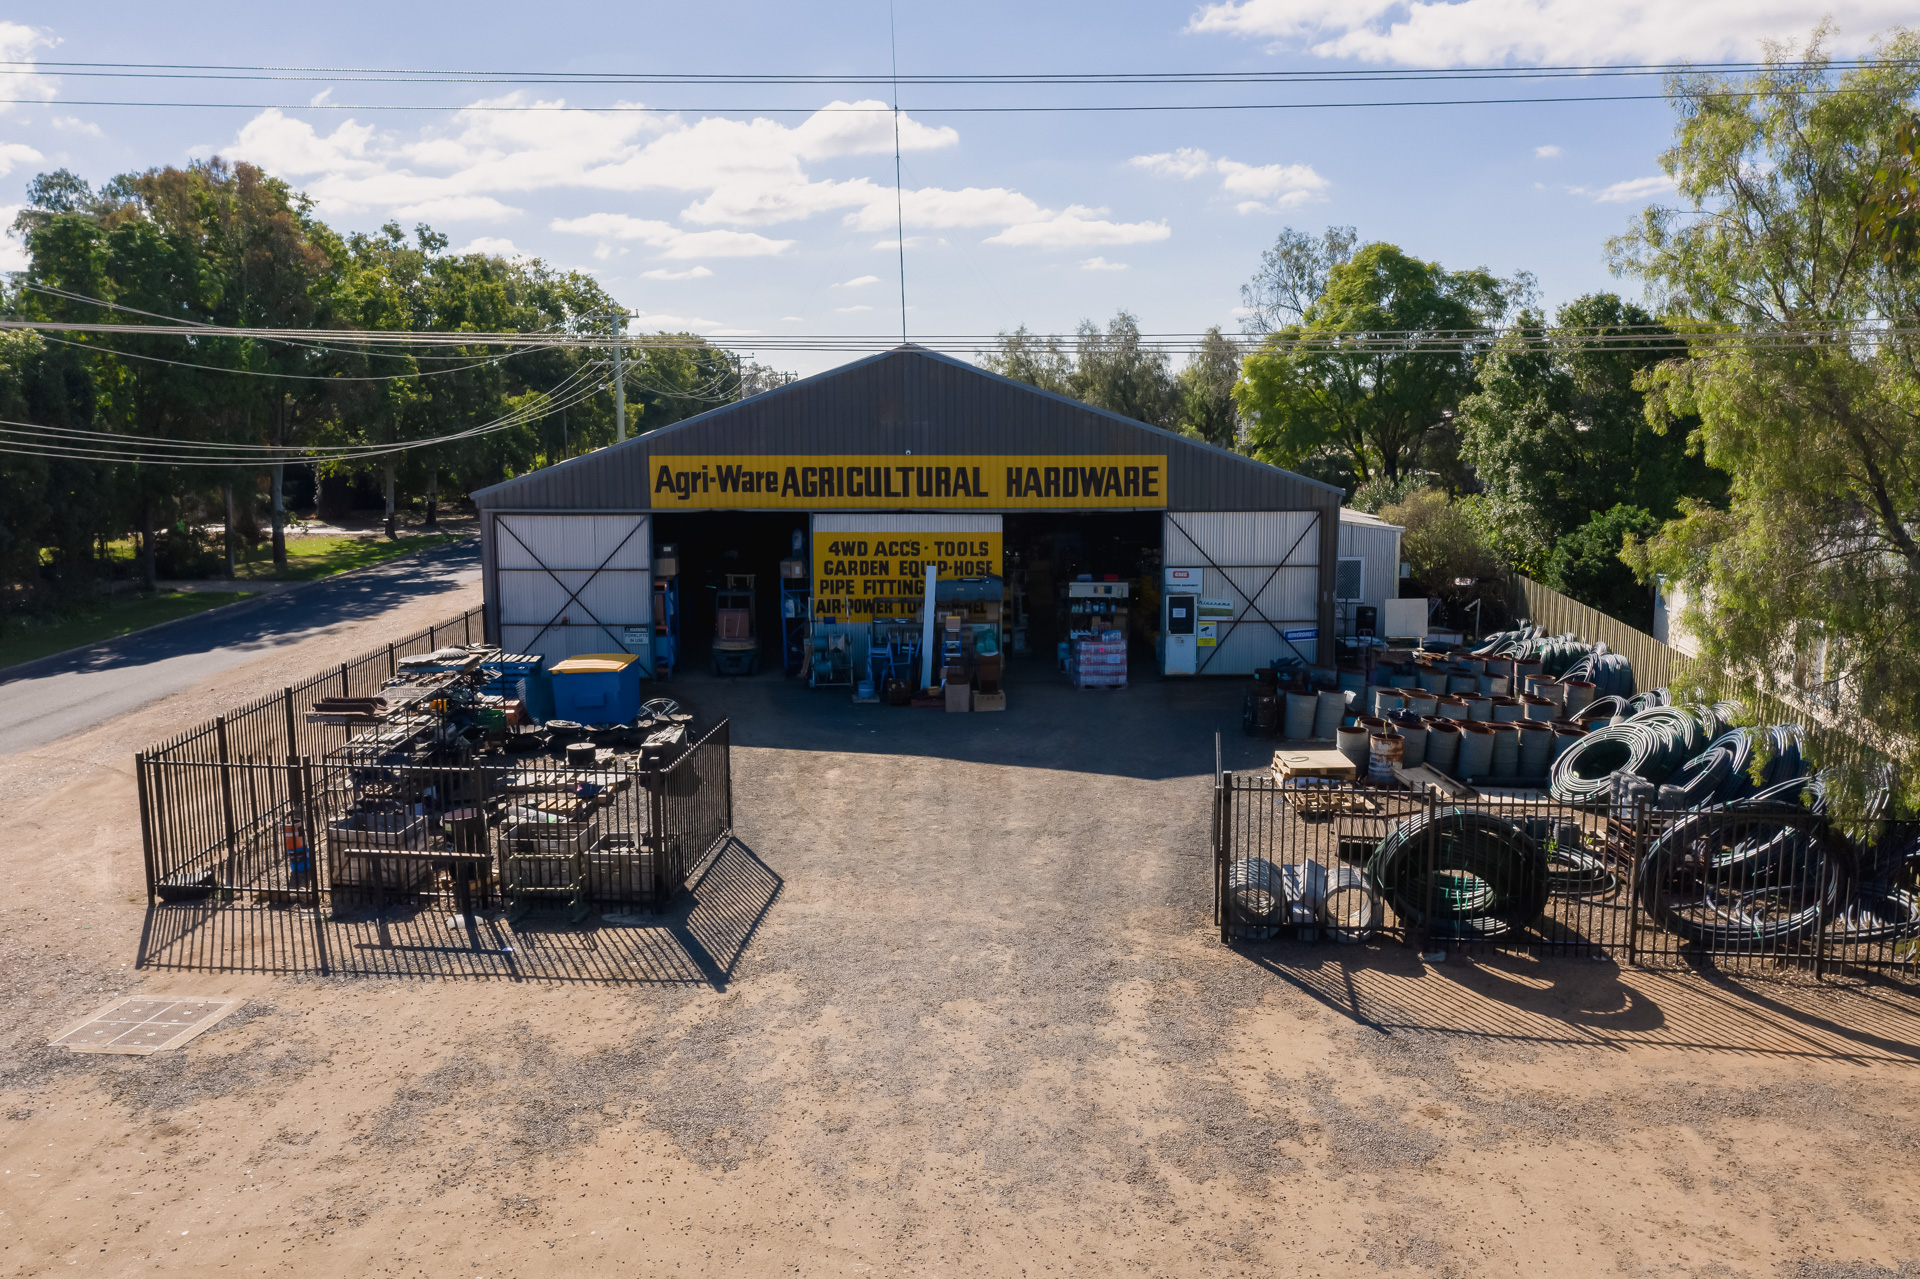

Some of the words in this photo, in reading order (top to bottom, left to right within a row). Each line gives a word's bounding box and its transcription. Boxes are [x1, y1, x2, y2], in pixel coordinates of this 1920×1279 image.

[654, 464, 778, 500] Agri-Ware
[781, 466, 989, 498] AGRICULTURAL
[1006, 466, 1159, 498] HARDWARE
[828, 540, 868, 557] 4WD
[934, 540, 989, 557] TOOLS
[823, 560, 890, 576] GARDEN
[819, 579, 855, 595] PIPE
